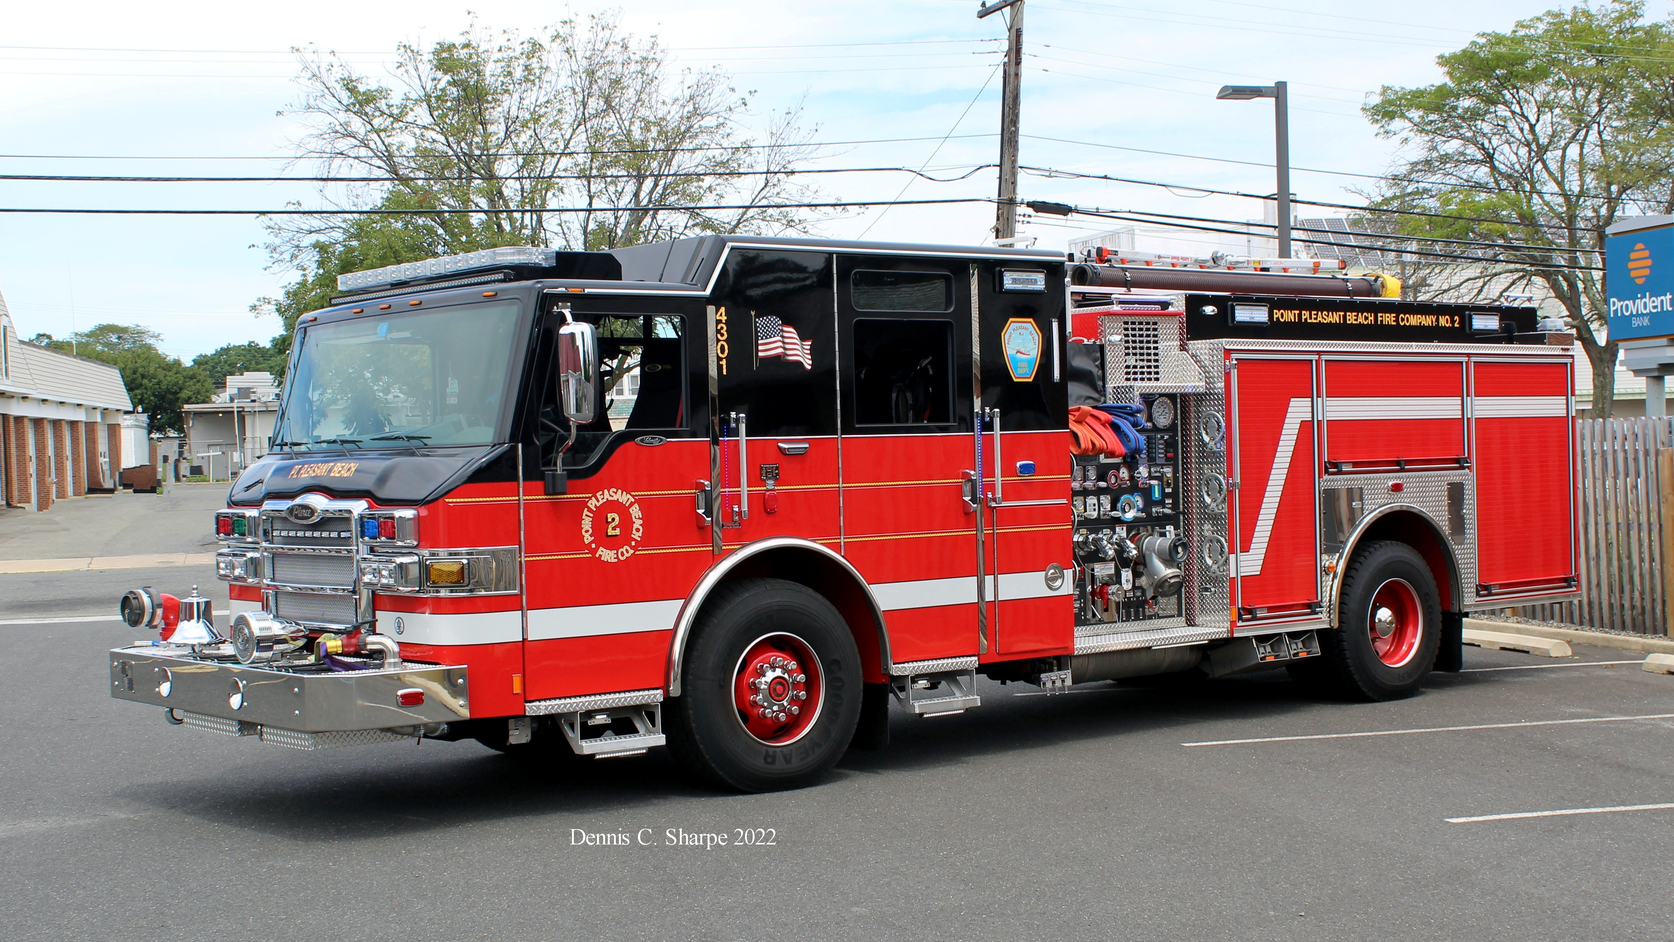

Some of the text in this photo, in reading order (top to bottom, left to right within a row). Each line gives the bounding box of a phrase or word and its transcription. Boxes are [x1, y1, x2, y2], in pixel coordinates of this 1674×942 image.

[1610, 291, 1673, 317] Provident
[1273, 309, 1460, 327] POINT PLEASANT BEACH FIRE COMPANY NO. 2
[1631, 316, 1650, 328] BANK
[716, 306, 728, 375] 4301
[298, 462, 335, 478] PLEASANT
[329, 462, 360, 477] BEACH
[581, 487, 643, 545] POINT PLEASANT BEACH
[606, 512, 620, 536] 2
[595, 546, 618, 562] FIRE
